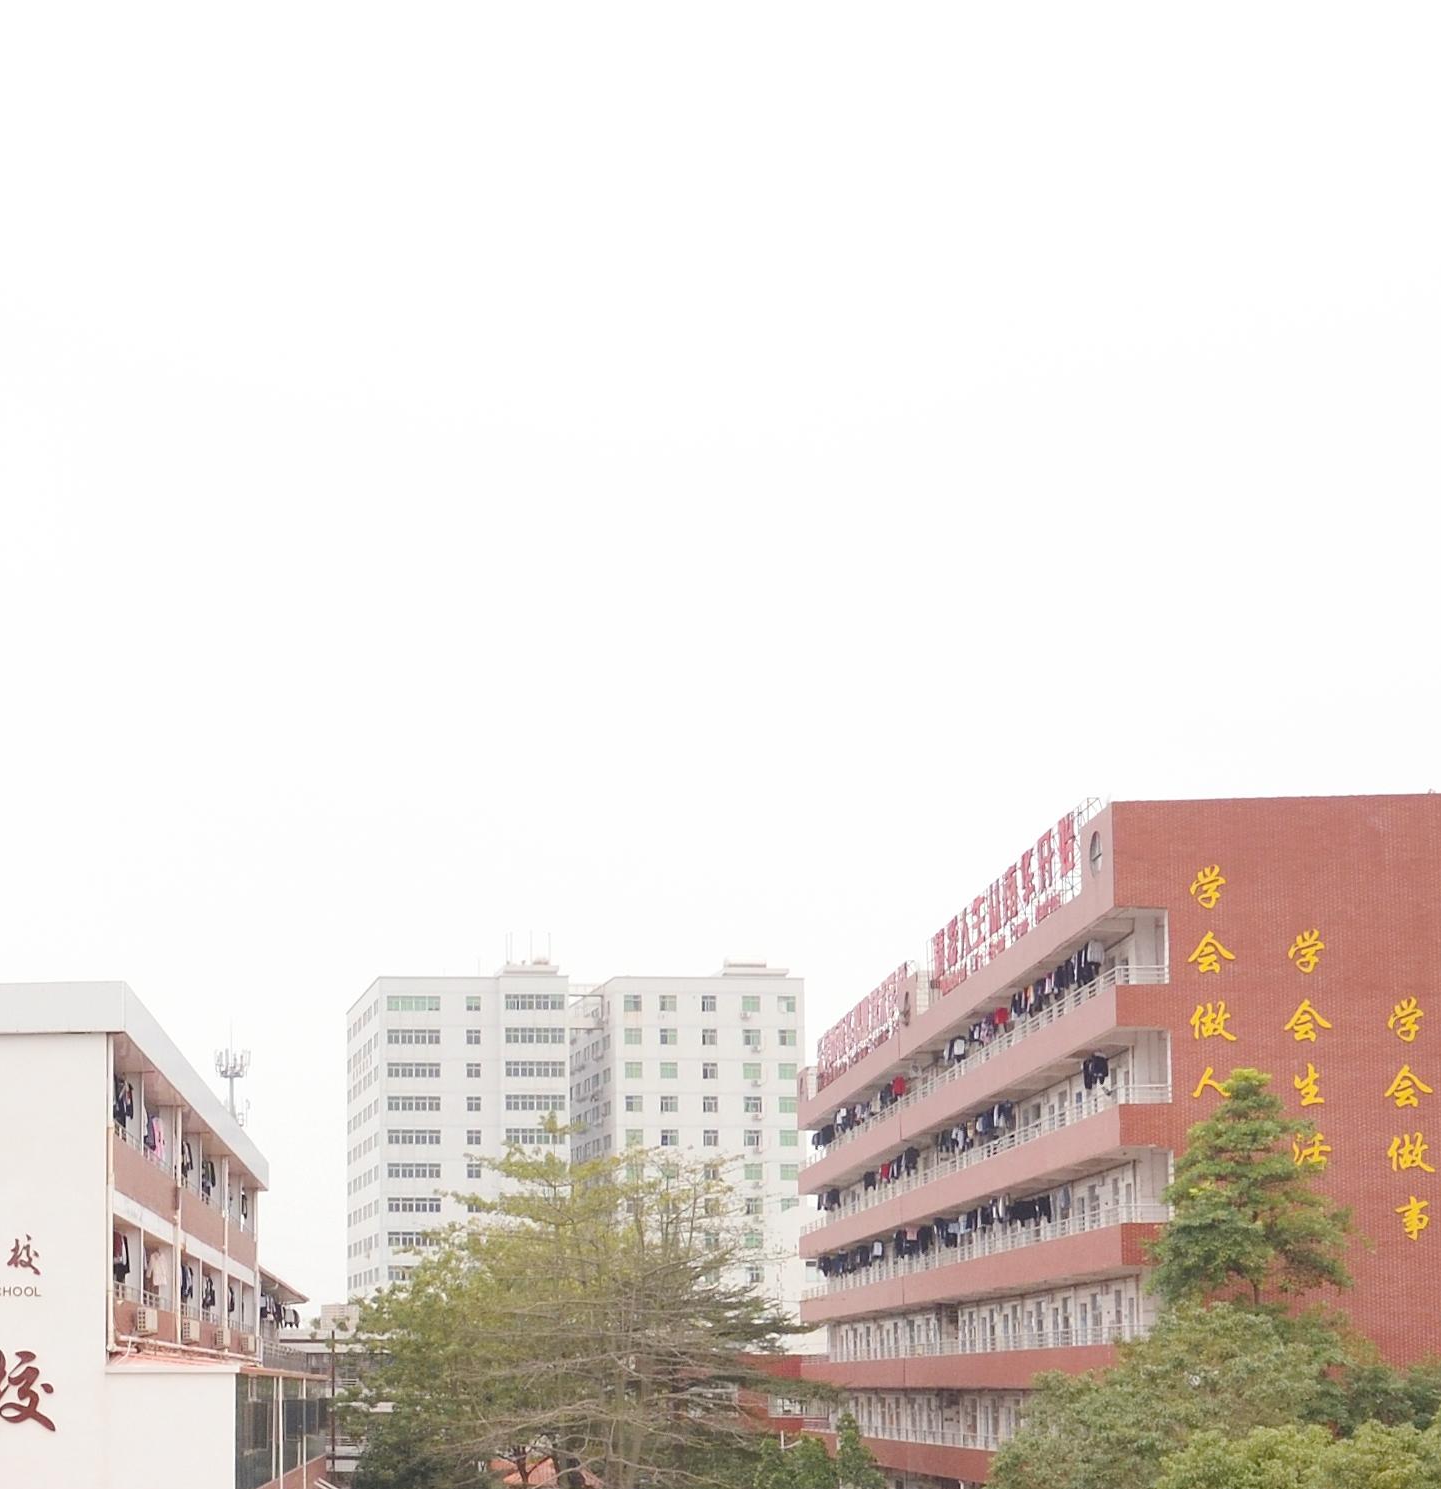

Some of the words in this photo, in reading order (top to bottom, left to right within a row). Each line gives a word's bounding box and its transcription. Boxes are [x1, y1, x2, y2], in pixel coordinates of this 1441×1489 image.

[1188, 864, 1237, 1098] 学会做人
[1284, 929, 1332, 1166] 学会生活
[1384, 997, 1435, 1241] 学会做事
